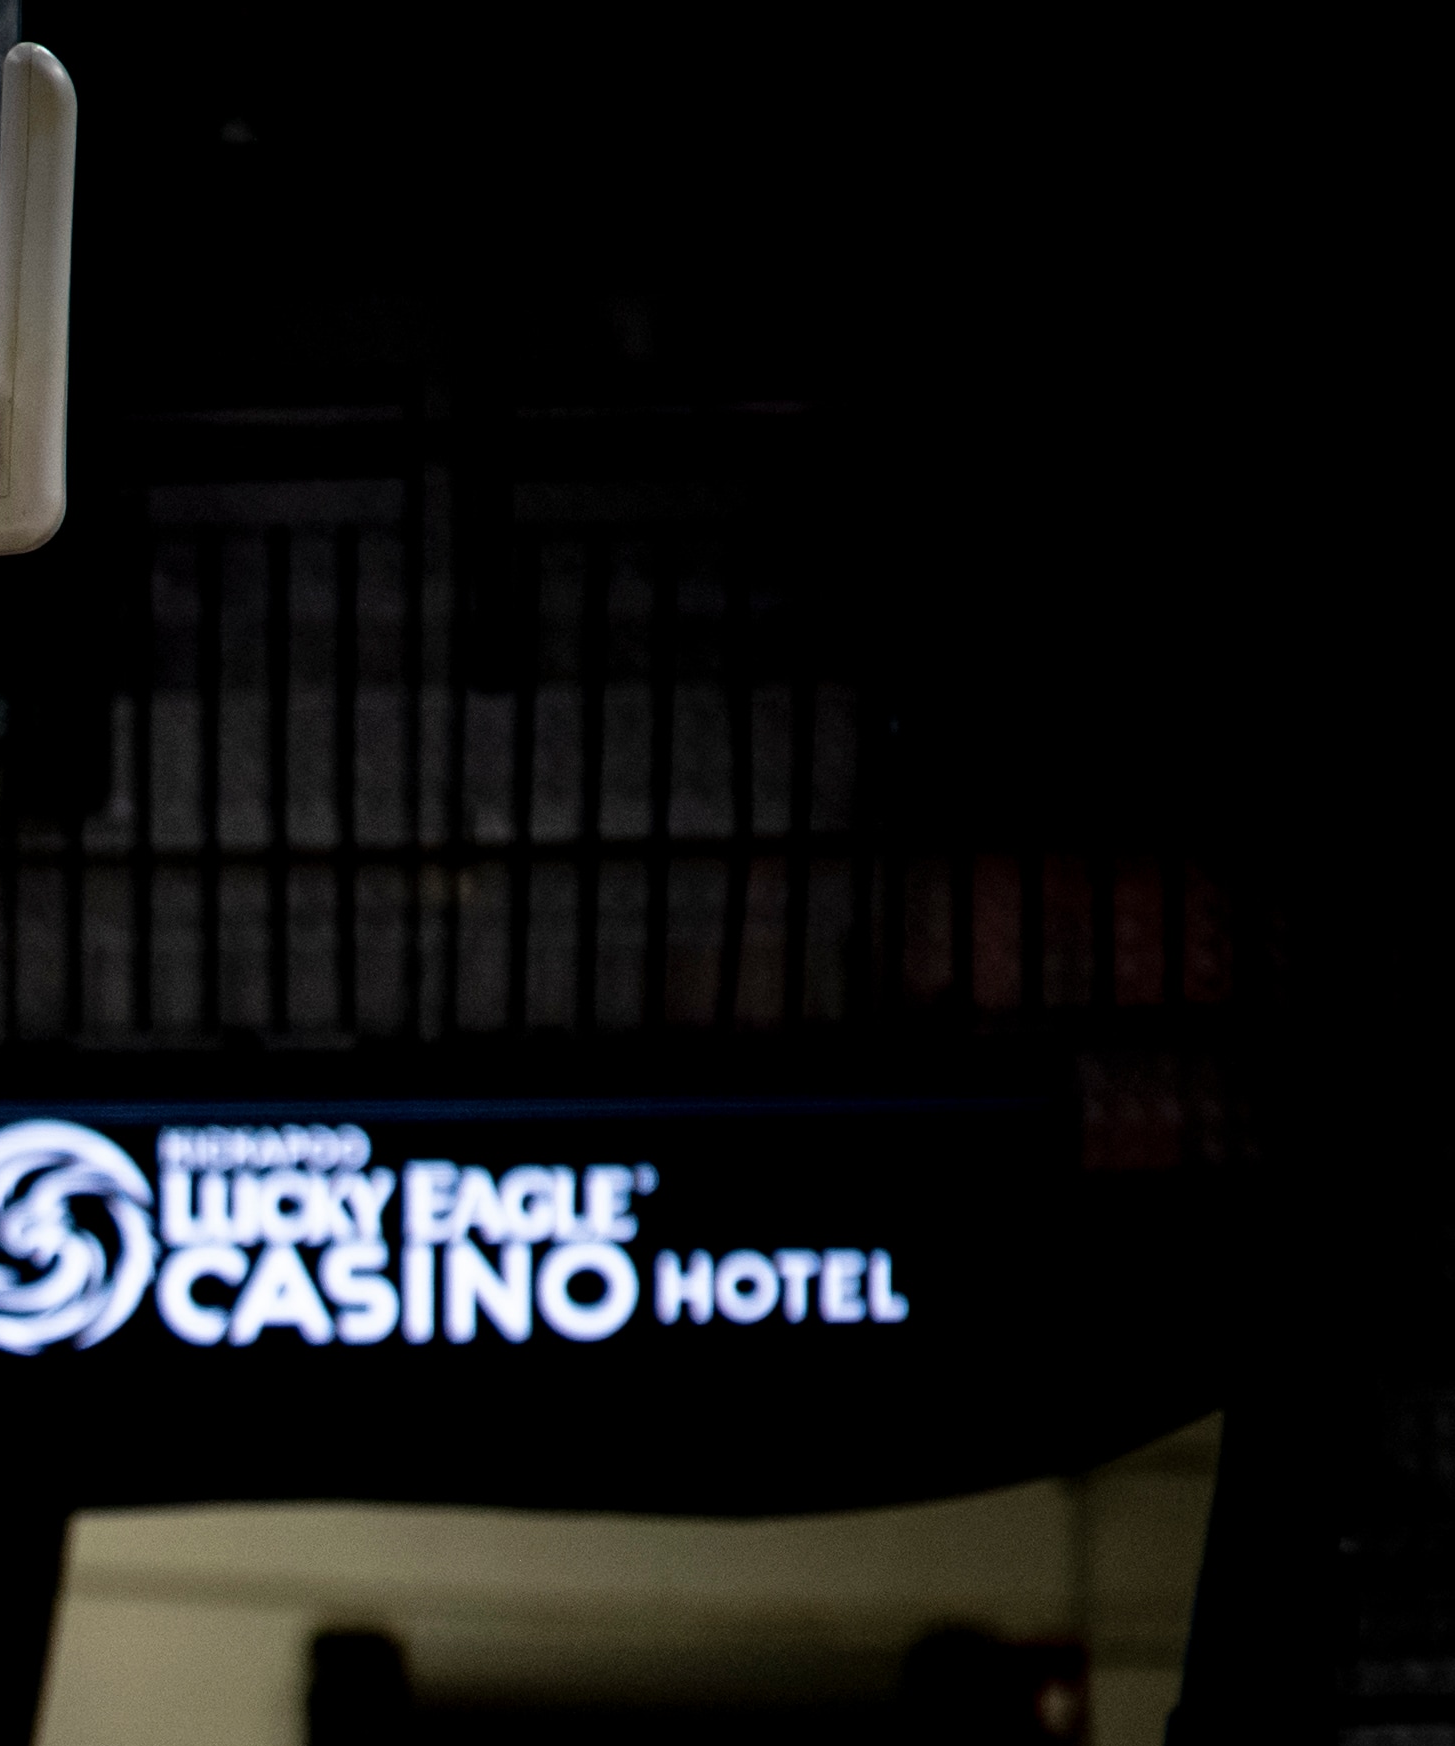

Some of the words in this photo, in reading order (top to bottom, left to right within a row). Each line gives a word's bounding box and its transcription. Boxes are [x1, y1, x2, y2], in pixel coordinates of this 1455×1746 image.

[160, 1164, 395, 1246] LUCKY
[403, 1160, 639, 1244] EAGLE
[156, 1242, 639, 1346] CASINO
[655, 1248, 910, 1325] HOTEL
